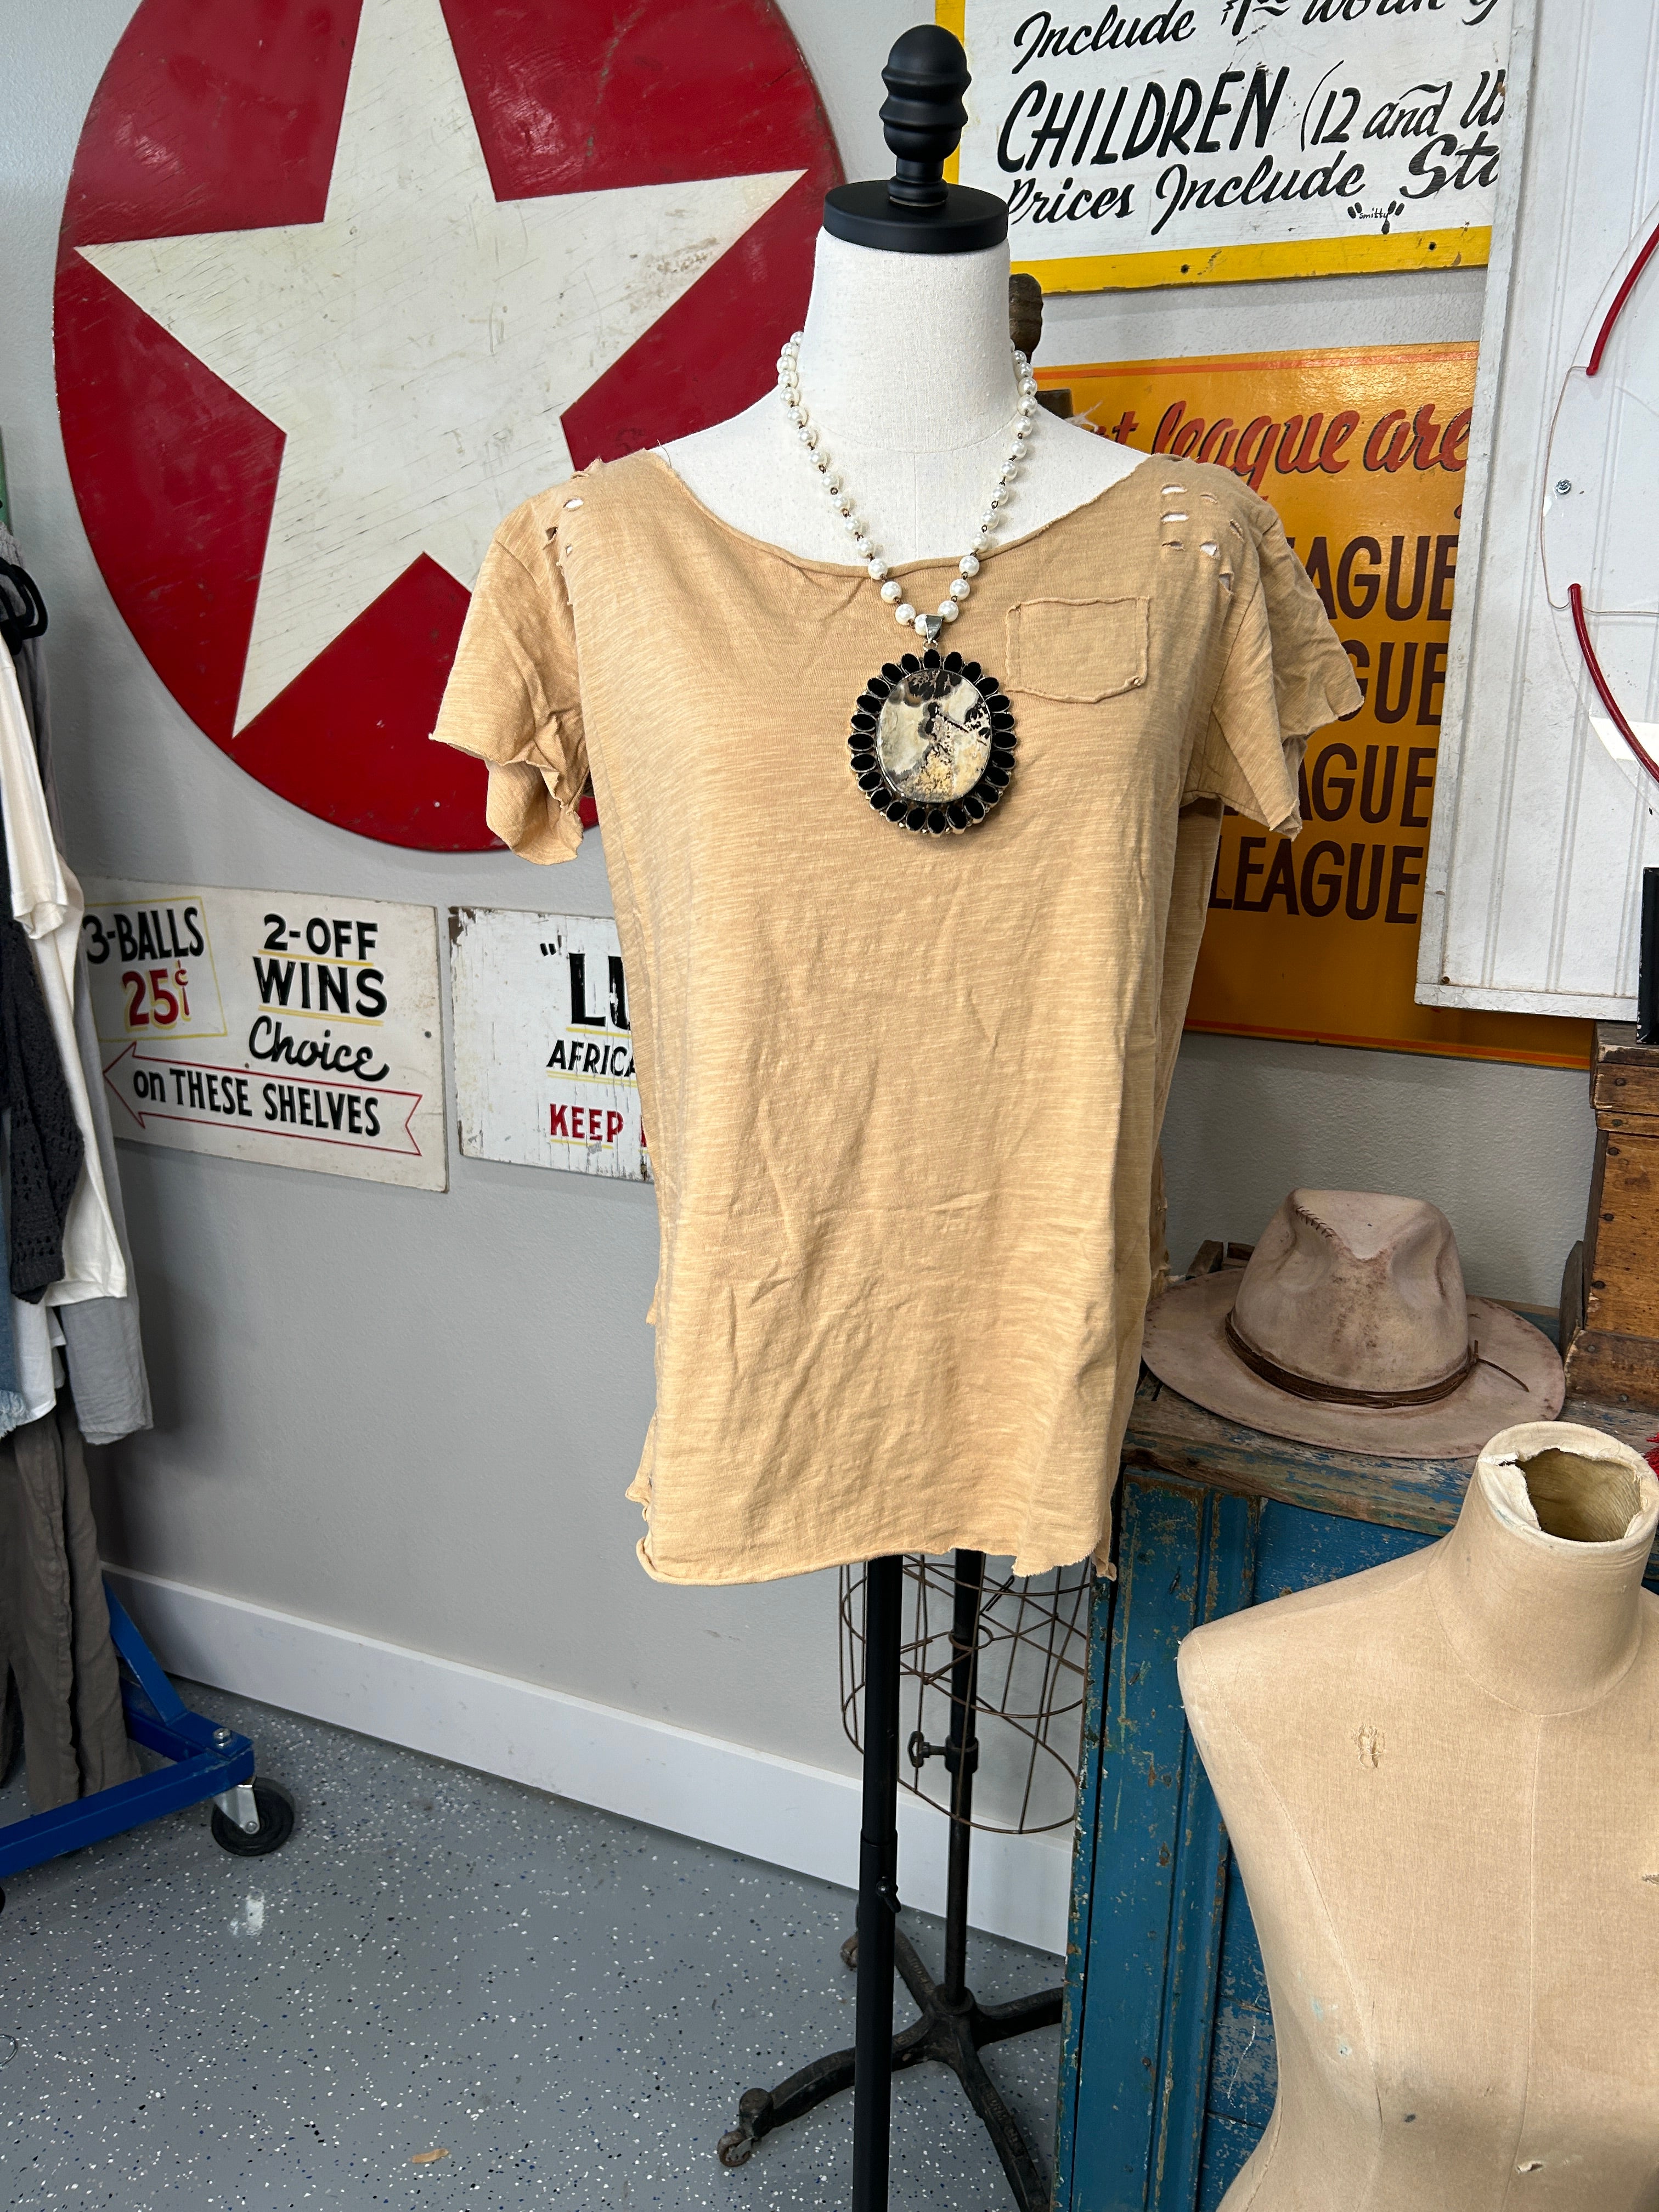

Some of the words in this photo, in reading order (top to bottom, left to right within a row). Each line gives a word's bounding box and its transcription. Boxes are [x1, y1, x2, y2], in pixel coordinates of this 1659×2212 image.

[1012, 0, 1197, 74] Include
[997, 66, 1289, 173] CHILDREN
[1300, 60, 1360, 152] (12
[1363, 81, 1452, 139] and
[1007, 177, 1136, 225] Prices
[1151, 150, 1364, 235] Include
[1152, 400, 1360, 493] league
[1363, 403, 1472, 472] are
[1287, 535, 1458, 621] AGUE
[1208, 834, 1423, 924] LEAGUE
[82, 906, 204, 964] 3-BALLS
[263, 912, 379, 961] 2-OFF
[121, 960, 190, 1028] 25¢
[253, 956, 388, 1018] WINS
[249, 1015, 390, 1081] Choice
[133, 1069, 166, 1102] on
[170, 1068, 253, 1118] THESE
[263, 1082, 381, 1137] SHELVES
[550, 1103, 624, 1143] KEEP
